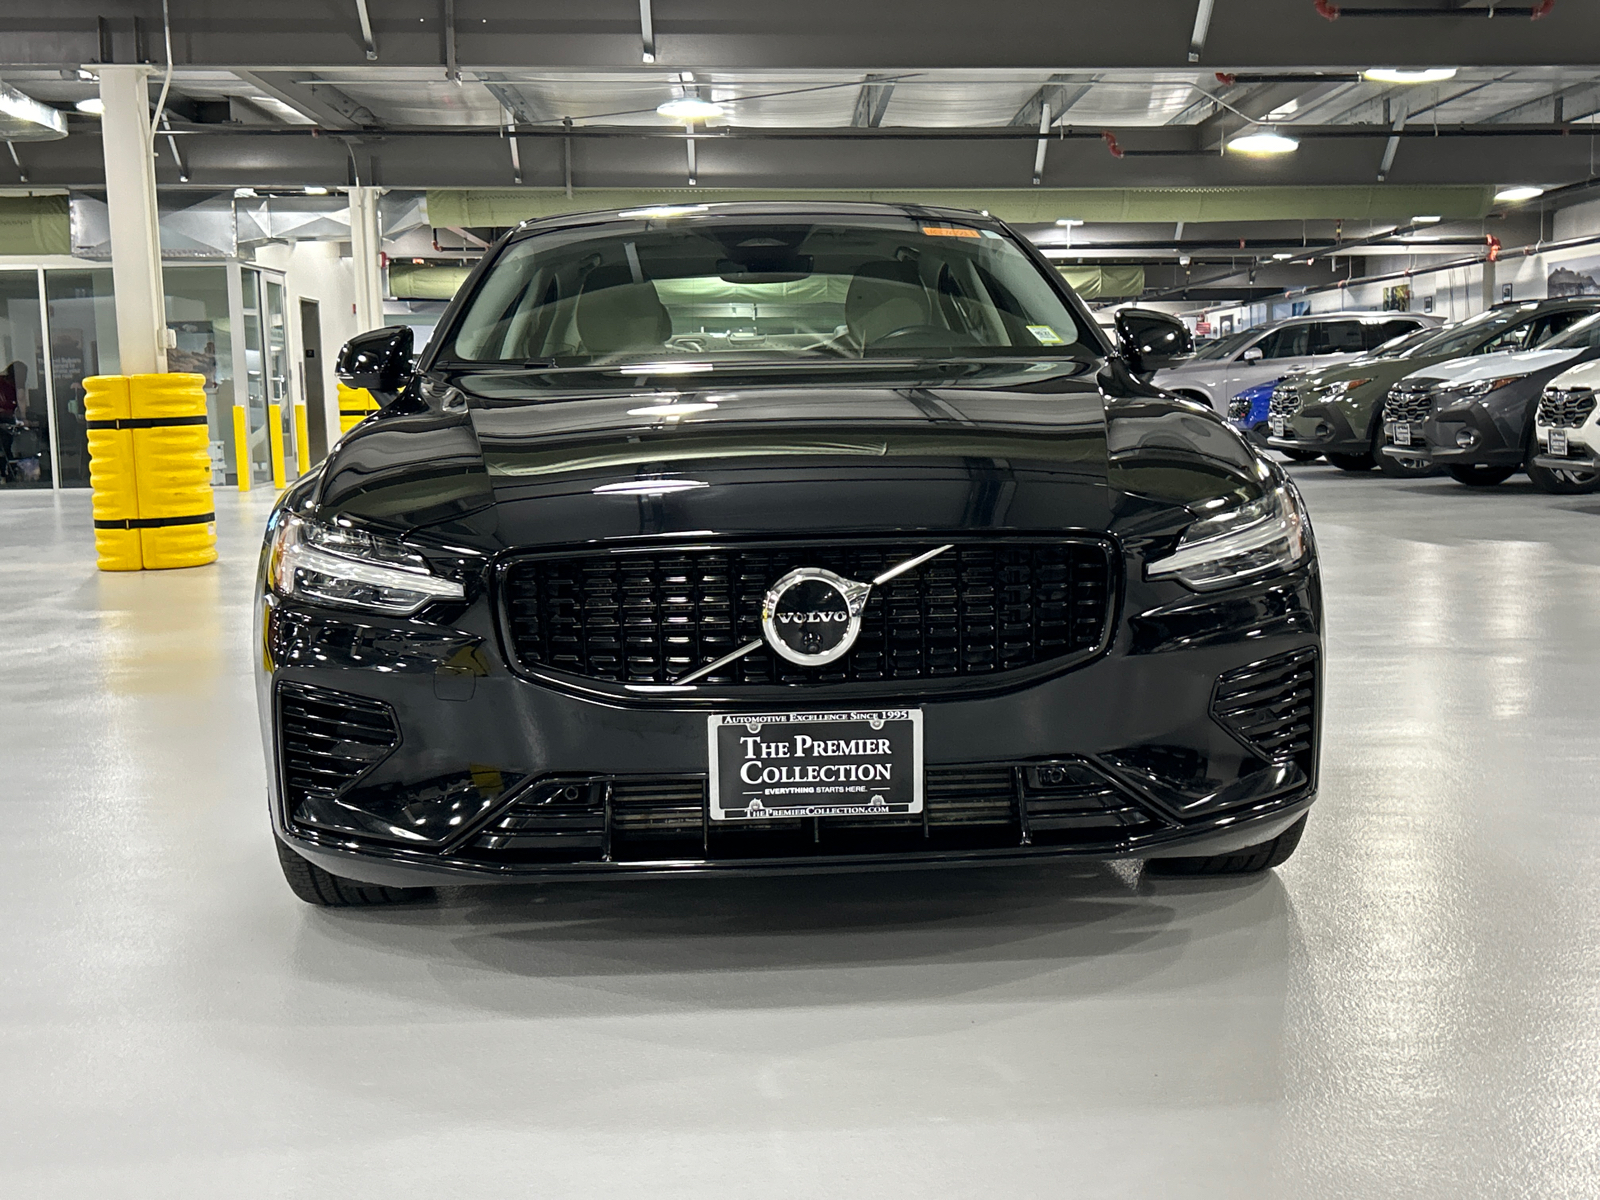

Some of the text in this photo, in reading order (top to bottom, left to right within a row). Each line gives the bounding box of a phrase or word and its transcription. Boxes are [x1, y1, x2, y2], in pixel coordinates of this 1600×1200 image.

[777, 611, 847, 624] VOLVO
[724, 710, 908, 724] AUTOMOTIVE EXCELLENCE SINCE 1995
[740, 735, 892, 759] THE PREMIER
[740, 760, 892, 784] COLLECTION
[764, 787, 814, 795] EVERYTHING
